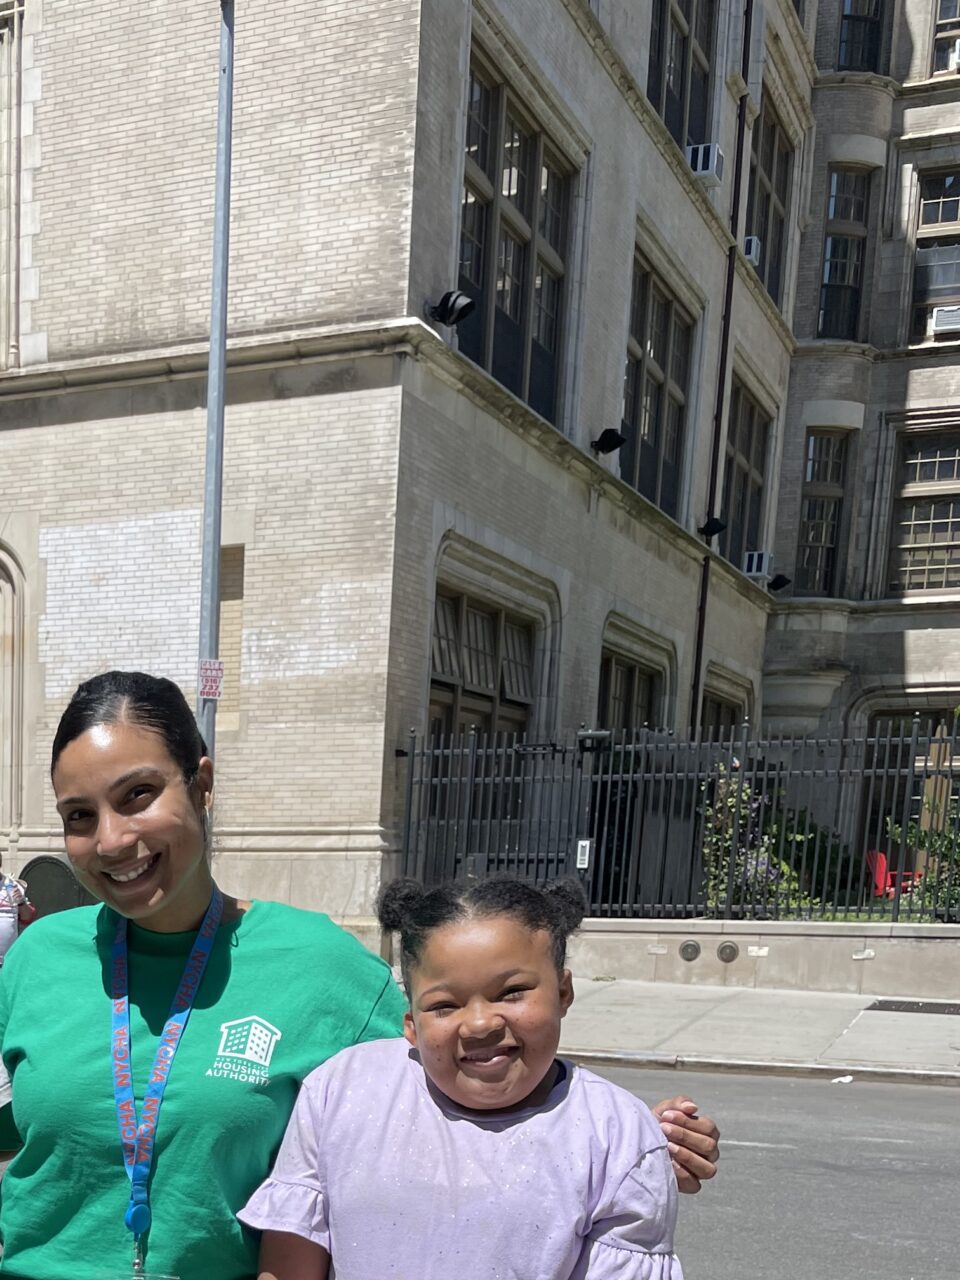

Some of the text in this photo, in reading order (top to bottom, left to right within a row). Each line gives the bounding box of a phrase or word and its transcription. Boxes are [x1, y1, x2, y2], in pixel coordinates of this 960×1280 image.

[113, 1024, 131, 1087] NYCHA
[150, 1021, 183, 1084] NYCHA
[213, 1061, 269, 1078] HOUSING
[205, 1068, 271, 1087] AUTHORITY
